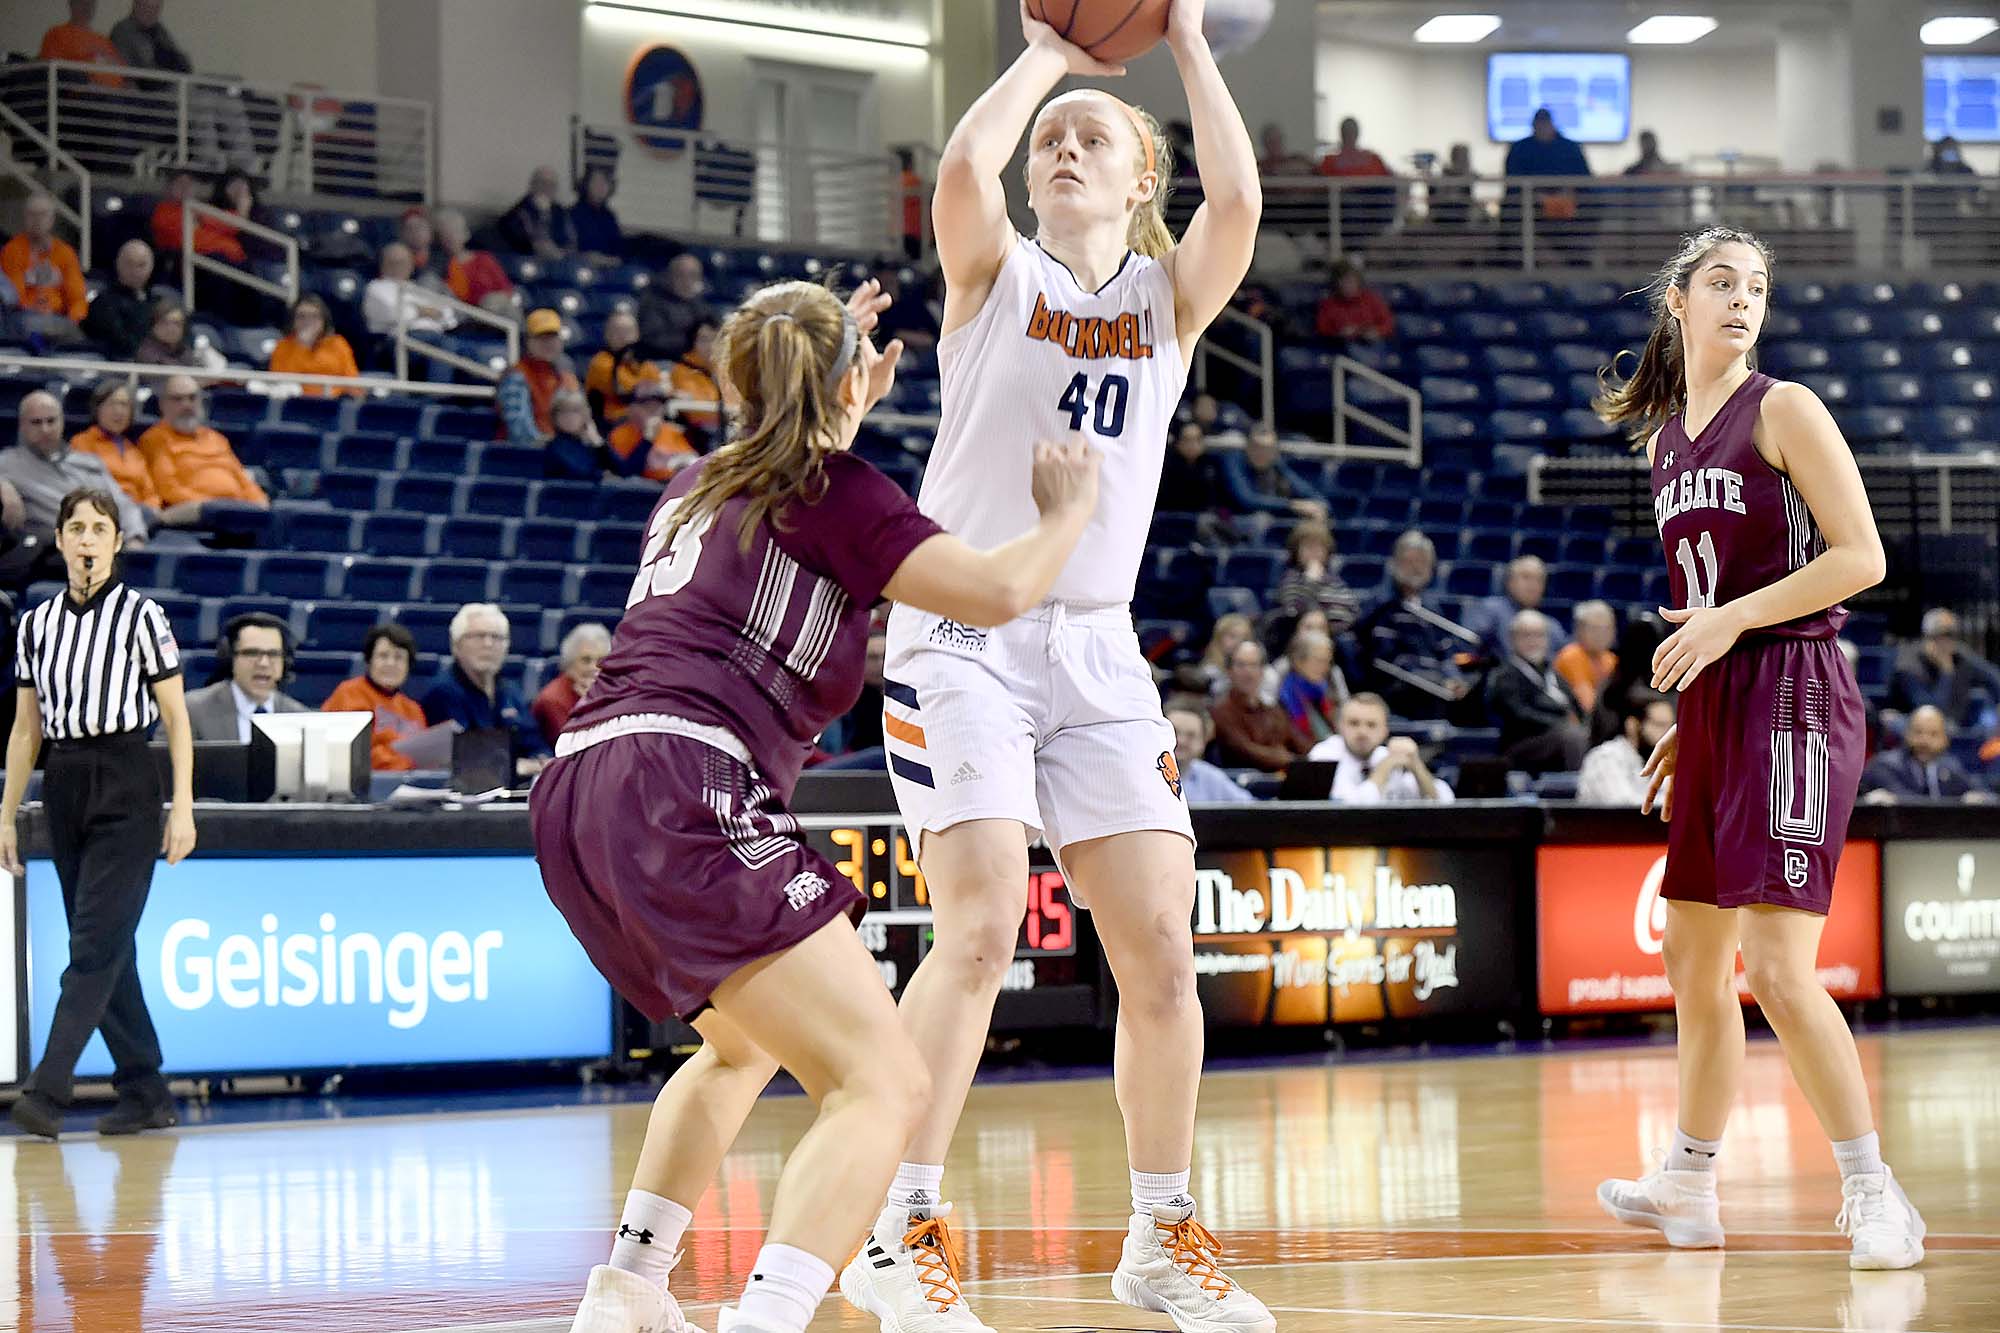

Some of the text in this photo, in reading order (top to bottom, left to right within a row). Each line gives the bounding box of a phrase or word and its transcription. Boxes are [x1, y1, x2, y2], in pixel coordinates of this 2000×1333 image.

[1057, 371, 1129, 437] 40
[1675, 531, 1718, 609] 11
[1027, 870, 1073, 951] 15
[1194, 865, 1458, 942] The Daily Item
[160, 912, 504, 1030] Geisinger
